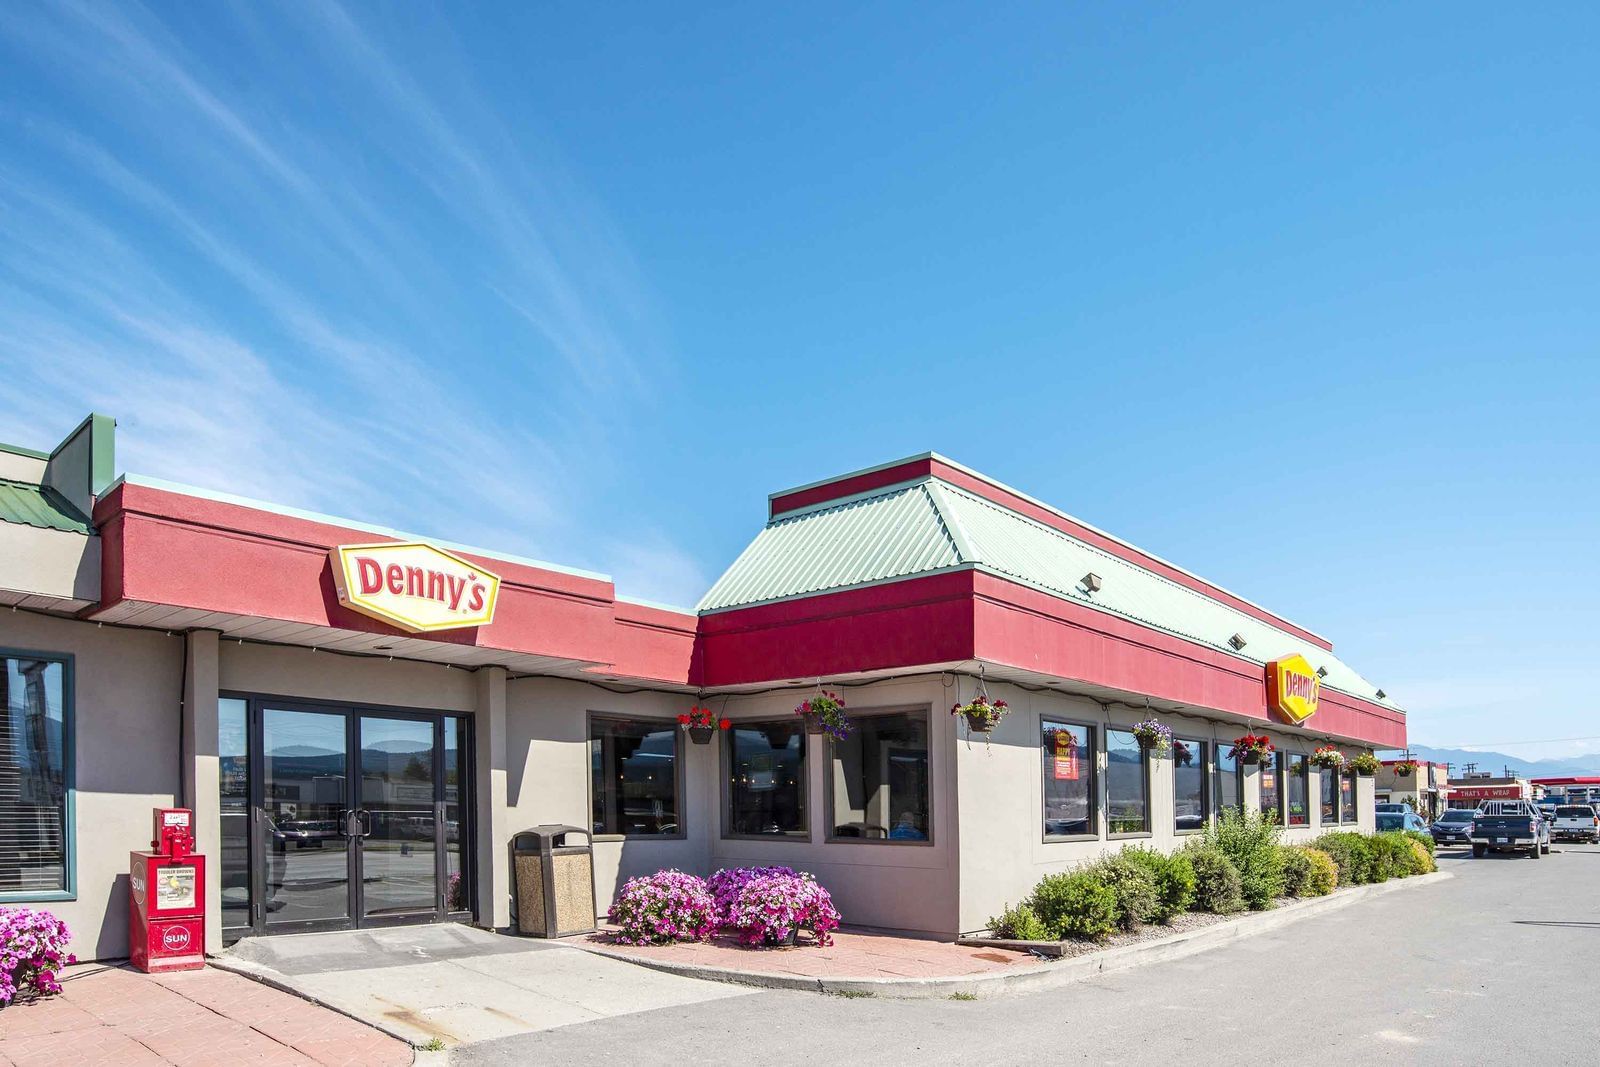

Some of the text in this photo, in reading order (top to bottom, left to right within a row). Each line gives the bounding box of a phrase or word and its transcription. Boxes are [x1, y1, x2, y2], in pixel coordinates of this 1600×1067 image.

[356, 557, 486, 611] Denny's
[1285, 669, 1317, 705] Denny's
[132, 876, 145, 892] SUN
[165, 934, 187, 943] SUN
